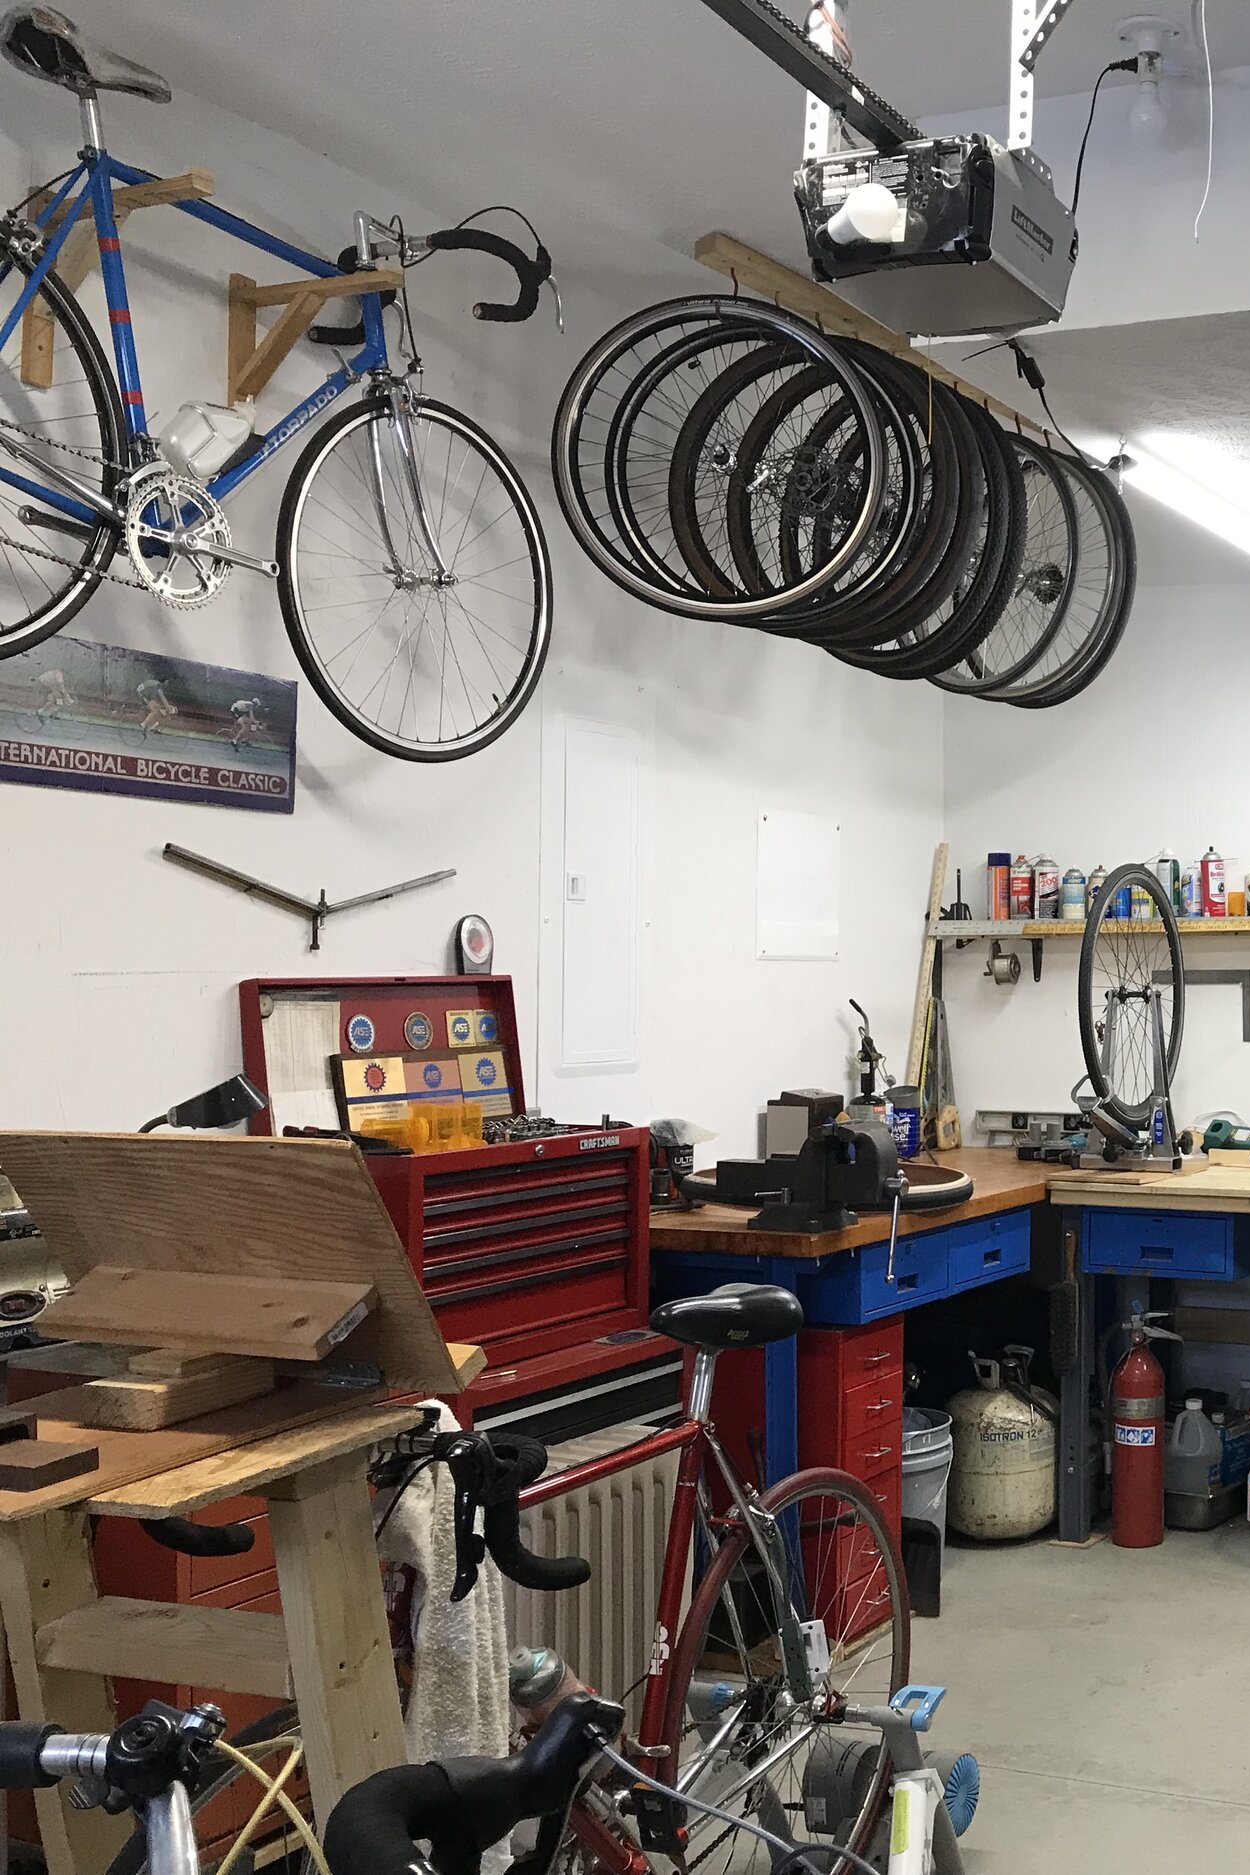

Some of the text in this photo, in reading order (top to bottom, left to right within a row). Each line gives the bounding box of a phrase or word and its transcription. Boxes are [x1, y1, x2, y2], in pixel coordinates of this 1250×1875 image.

[268, 385, 338, 448] TORPADO
[0, 741, 282, 793] TERNATIONAL BICYCLE CLASSIC
[353, 1027, 370, 1037] ASE
[412, 1025, 426, 1035] ASE
[454, 1023, 468, 1033] ASE
[425, 1070, 440, 1081] ASE
[478, 1065, 494, 1077] ASE
[580, 1136, 620, 1150] CRAFTSMAN
[674, 1156, 694, 1165] ULTR
[979, 1429, 1037, 1443] ISOTRON 12
